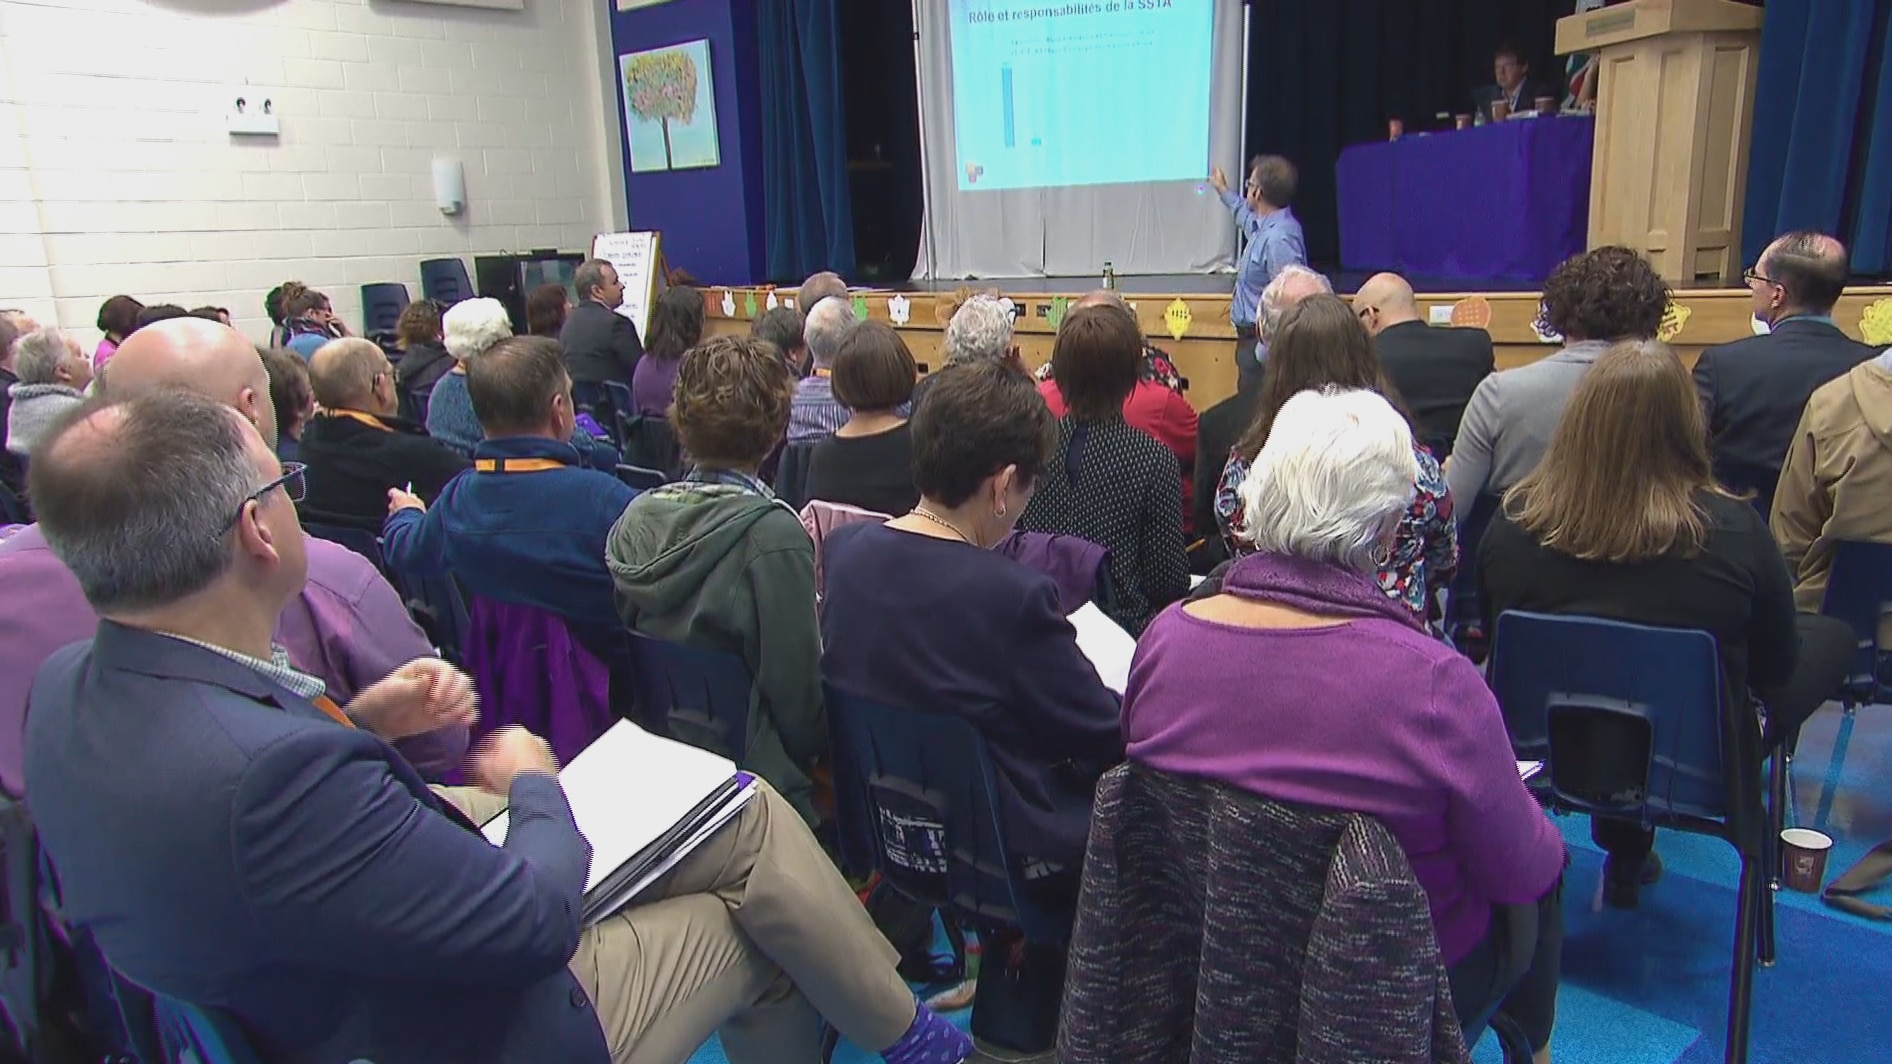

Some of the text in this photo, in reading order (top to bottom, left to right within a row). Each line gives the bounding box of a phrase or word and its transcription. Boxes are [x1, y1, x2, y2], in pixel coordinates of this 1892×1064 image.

[968, 9, 994, 24] Rôle
[997, 9, 1009, 21] et
[1012, 3, 1101, 20] responsabilités
[1105, 0, 1120, 13] de
[1124, 0, 1134, 11] la
